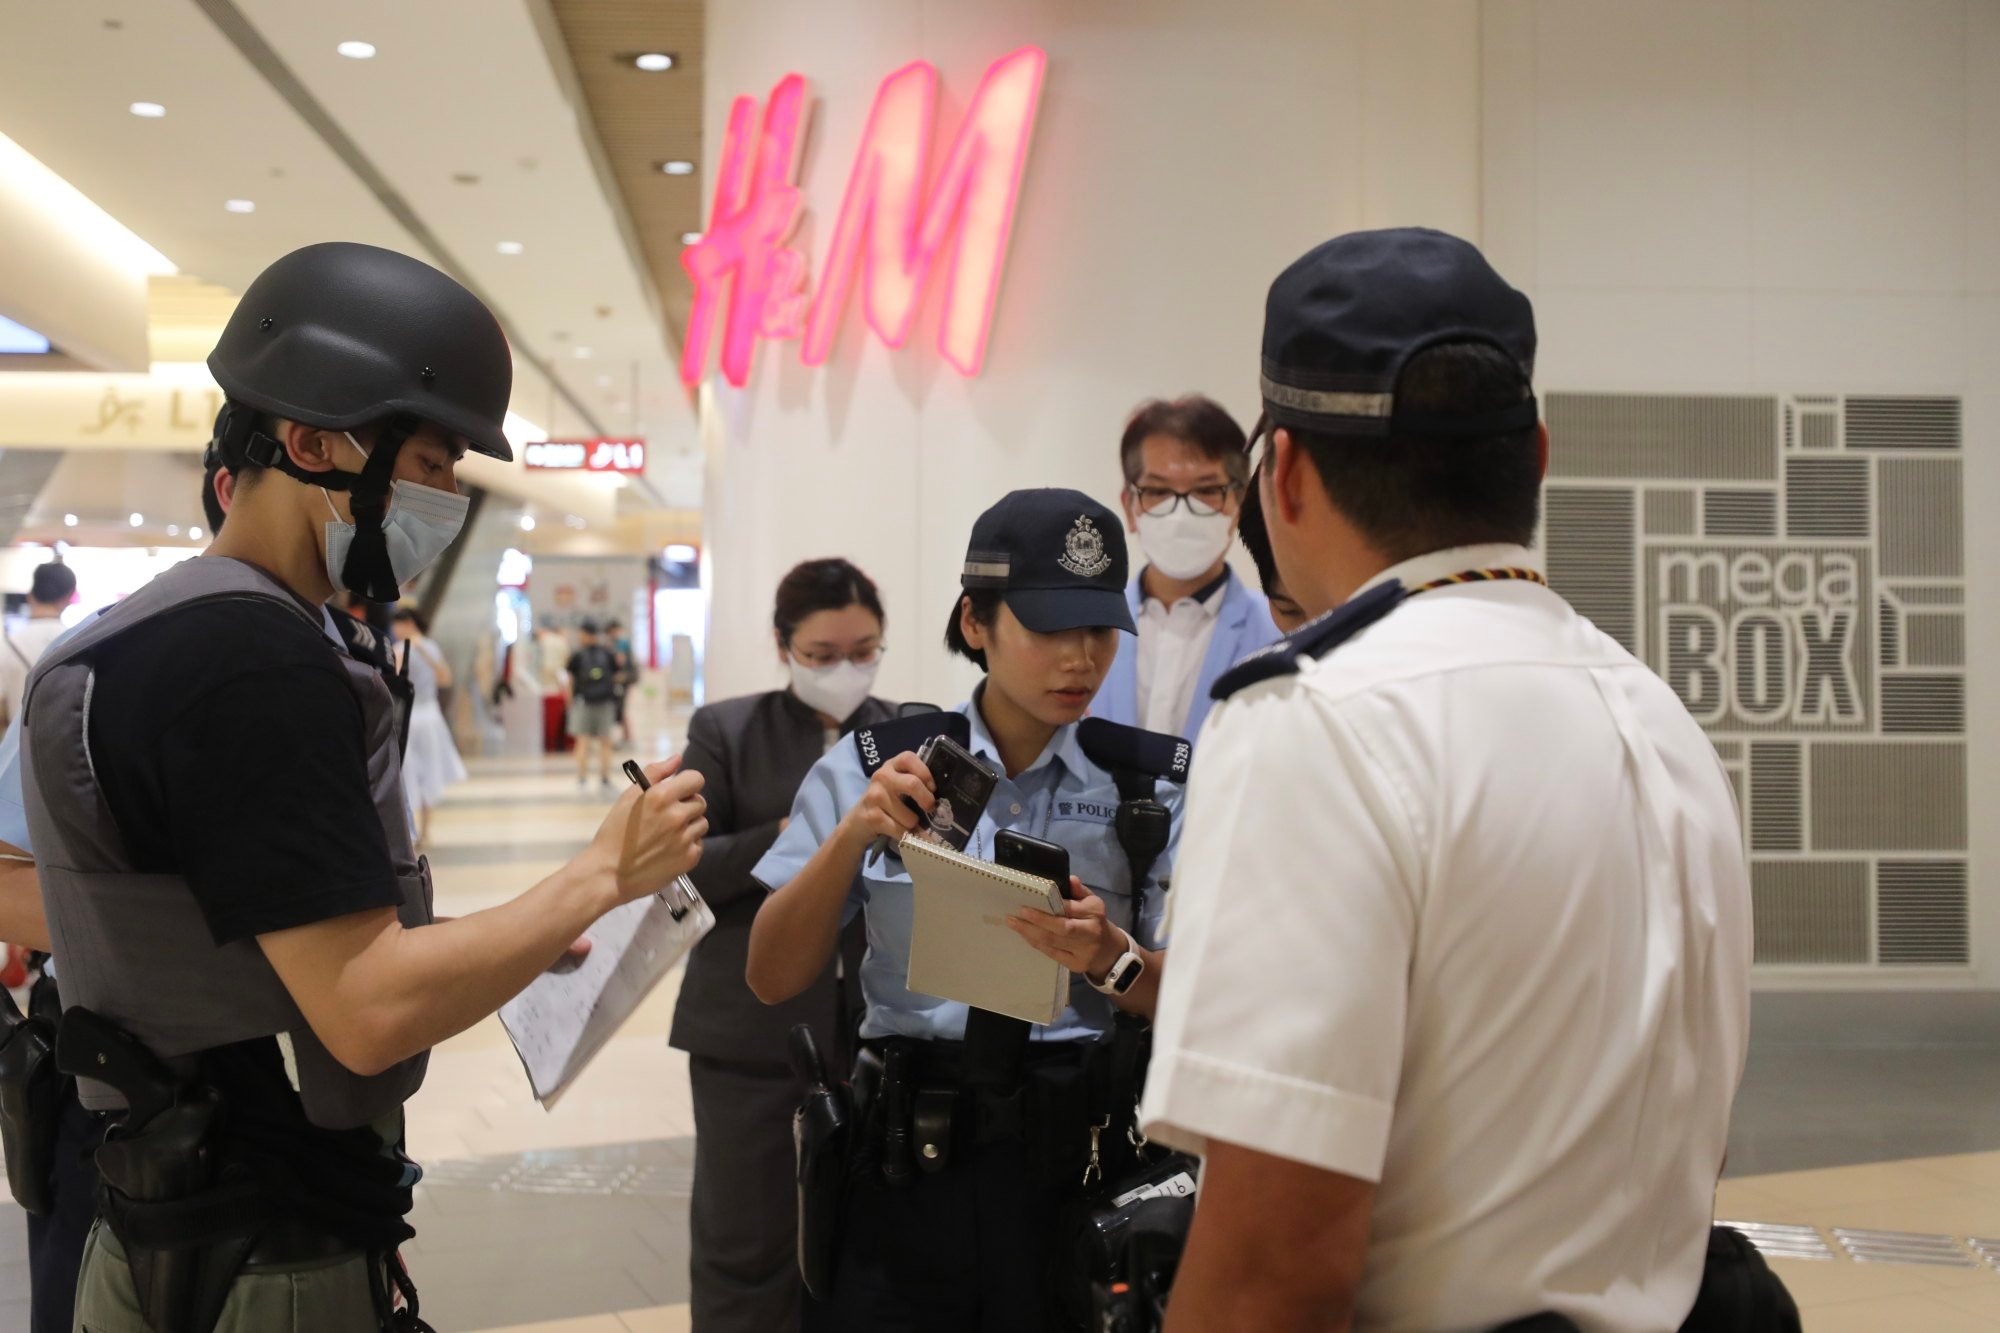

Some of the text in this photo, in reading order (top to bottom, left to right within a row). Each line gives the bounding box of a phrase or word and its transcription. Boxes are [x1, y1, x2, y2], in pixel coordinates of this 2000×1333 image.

[680, 45, 1048, 389] H&M
[1658, 551, 1860, 608] mega
[1658, 604, 1866, 726] BOX
[859, 729, 881, 766] 35293
[1077, 802, 1117, 819] POLIC
